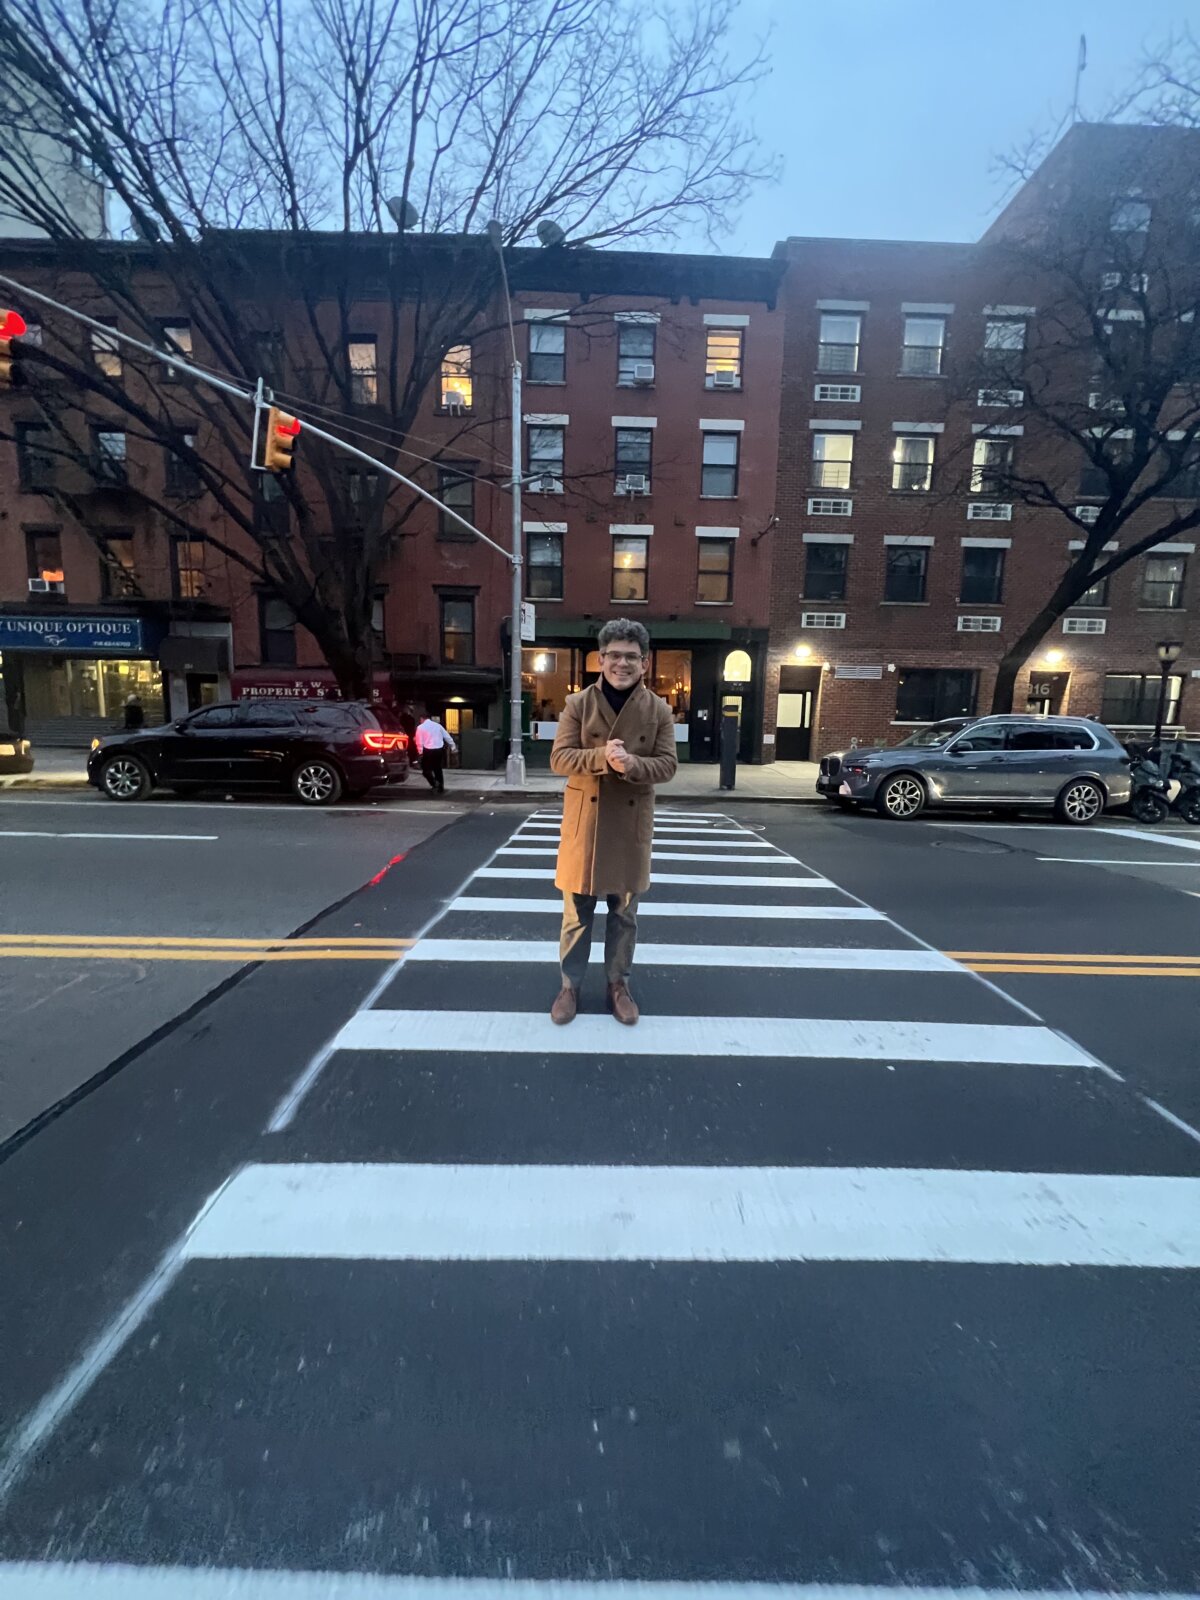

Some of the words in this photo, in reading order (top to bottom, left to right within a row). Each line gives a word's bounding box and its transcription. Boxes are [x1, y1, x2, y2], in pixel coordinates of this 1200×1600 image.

[7, 621, 64, 634] UNIQUE
[66, 622, 132, 636] OPTIQUE
[242, 687, 309, 697] PROPERTY
